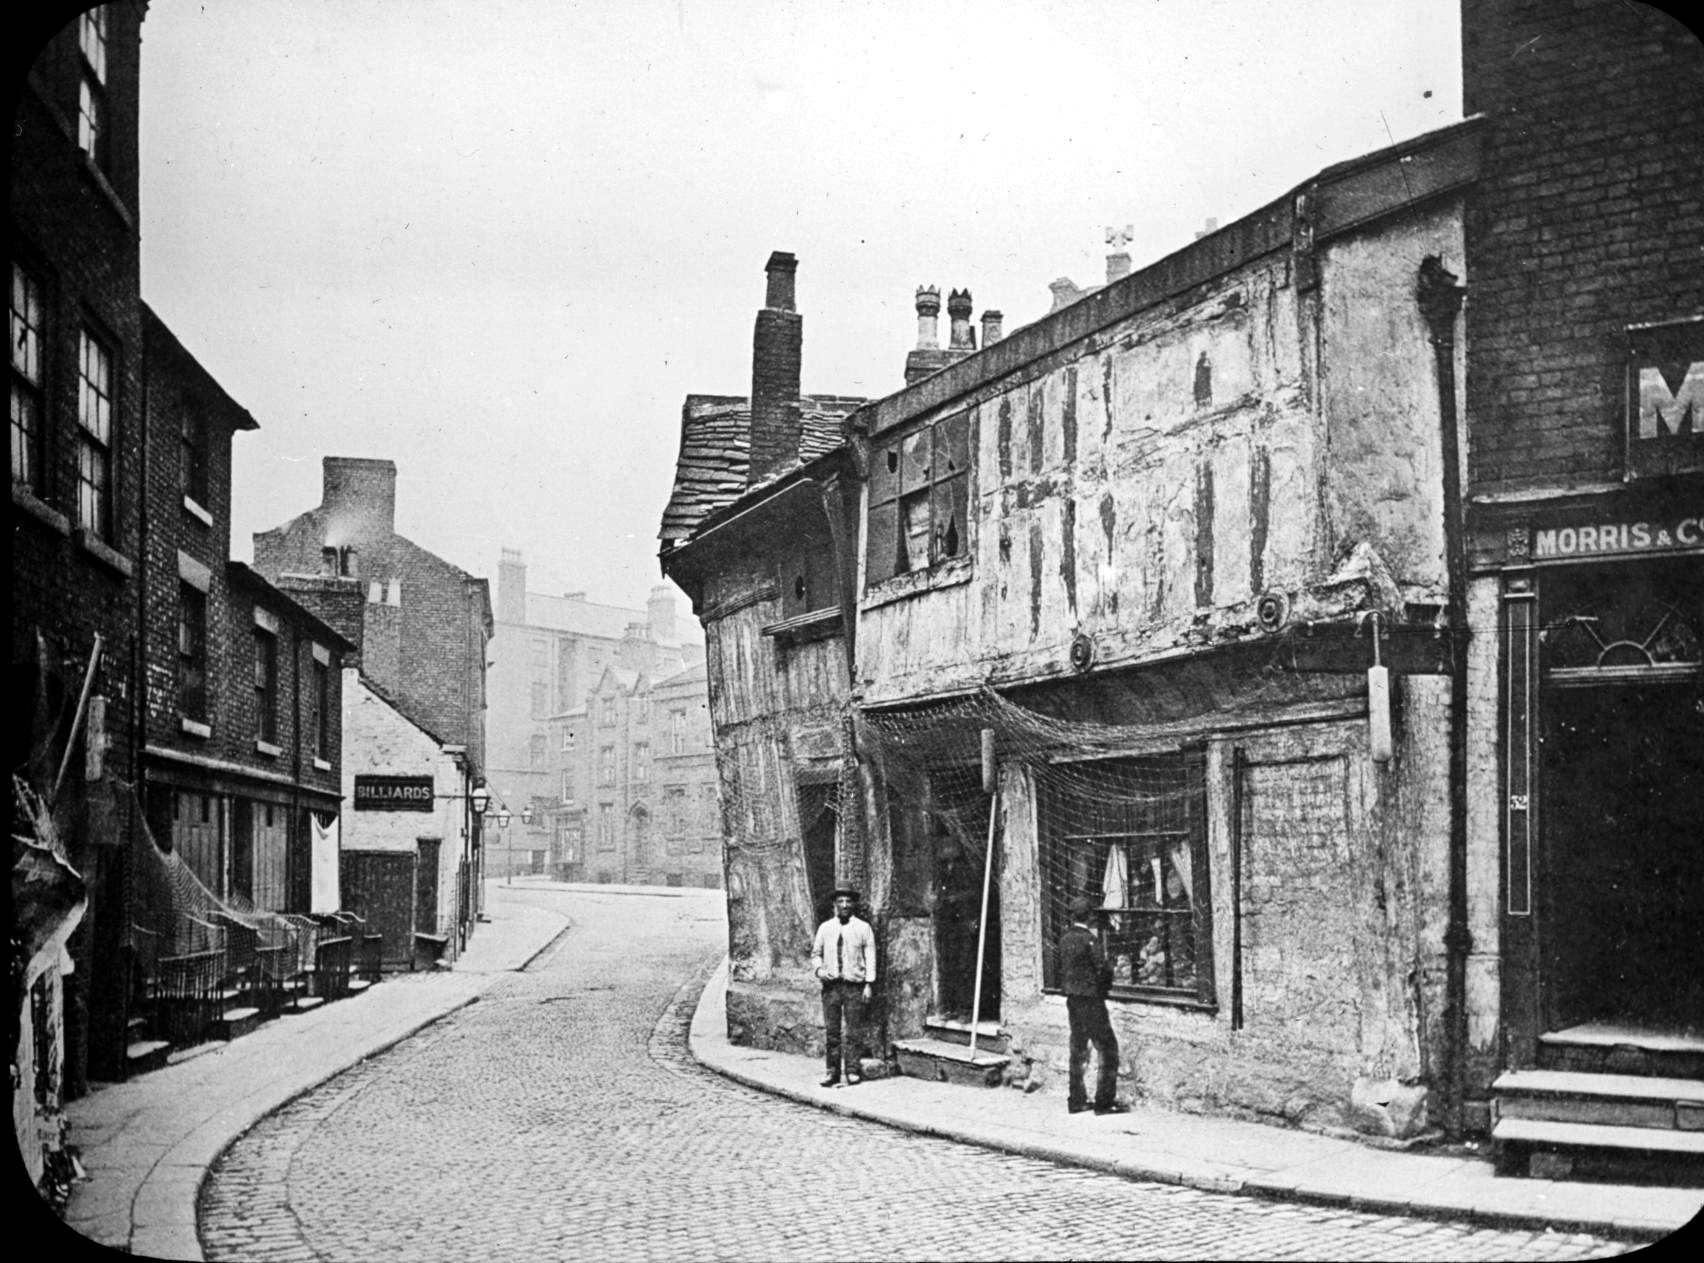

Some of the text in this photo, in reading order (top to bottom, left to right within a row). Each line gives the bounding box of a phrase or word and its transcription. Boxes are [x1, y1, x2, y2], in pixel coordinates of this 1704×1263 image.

[1639, 362, 1704, 439] M
[1536, 522, 1651, 556] MORRIS
[1656, 529, 1672, 546] &
[357, 785, 431, 800] BILLIARDS
